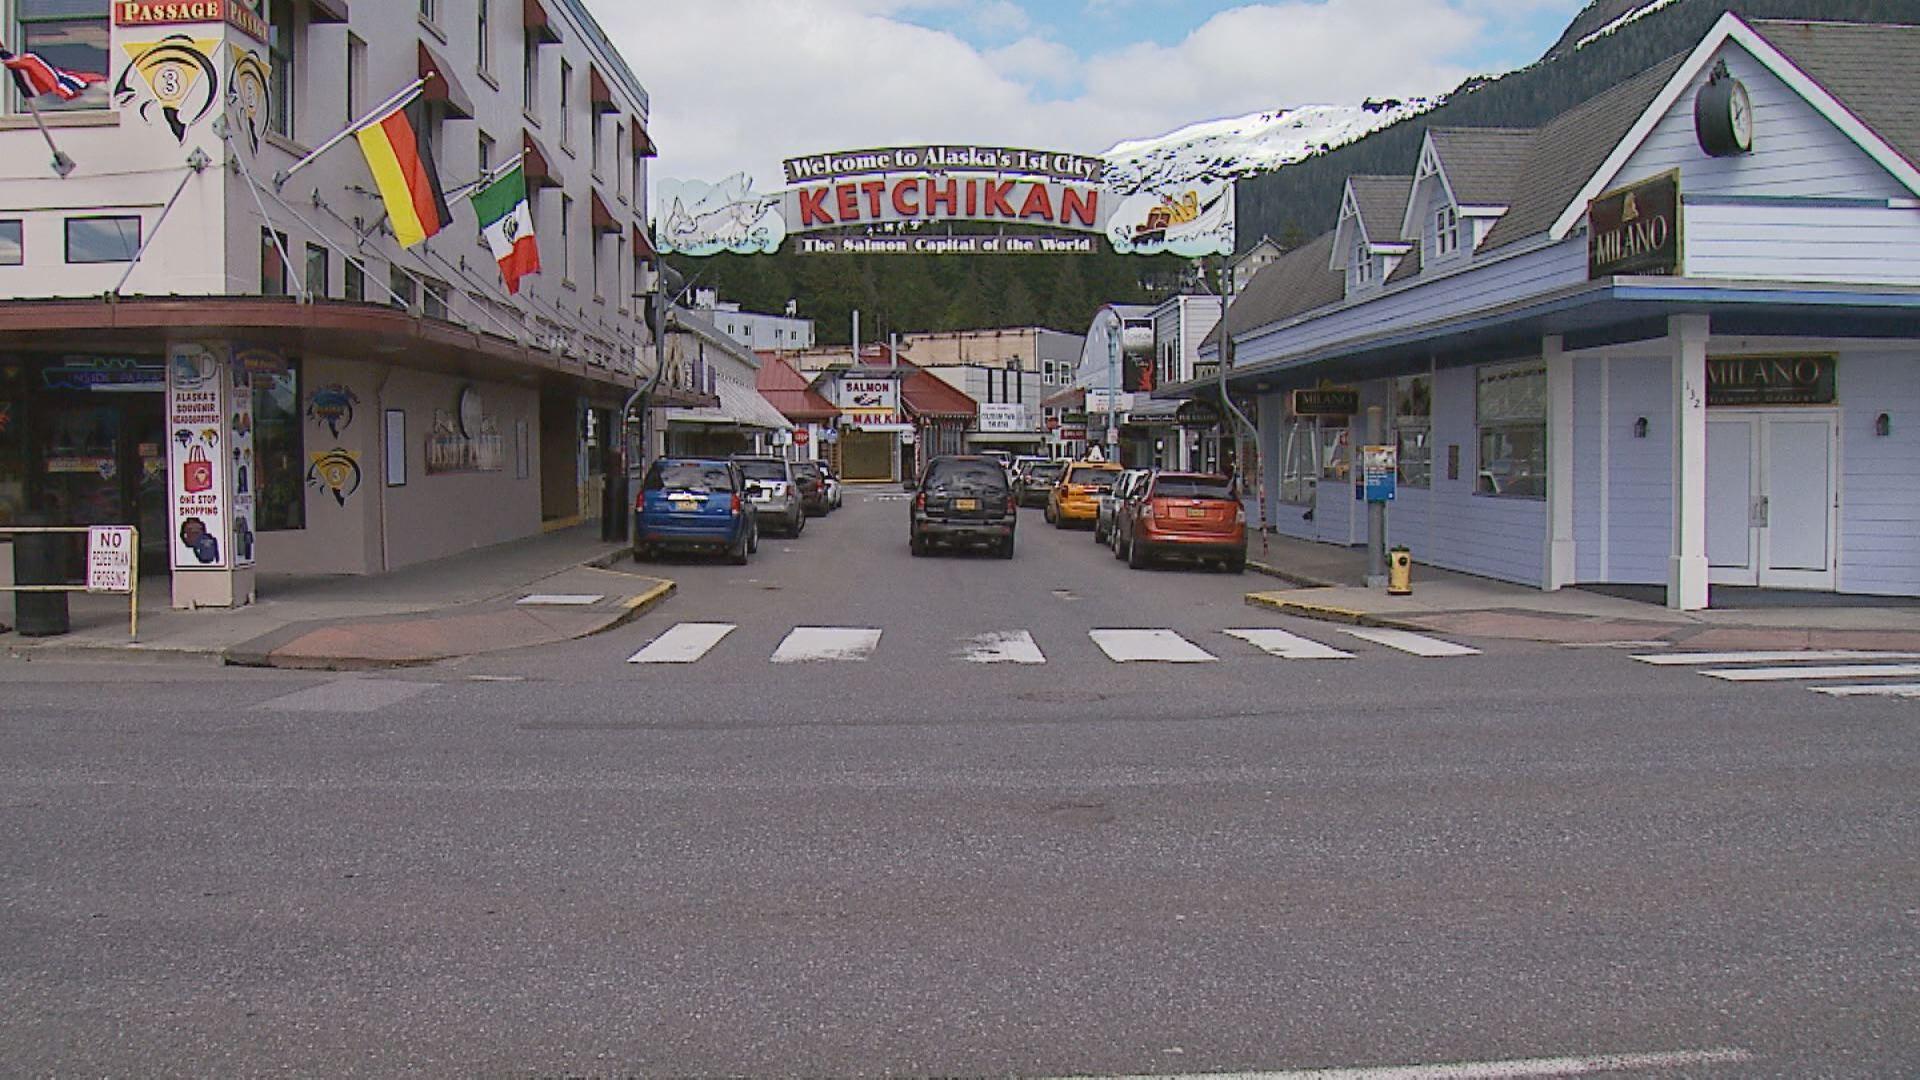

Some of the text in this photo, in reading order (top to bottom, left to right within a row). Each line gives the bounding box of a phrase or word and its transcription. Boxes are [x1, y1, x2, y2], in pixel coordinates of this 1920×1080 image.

[125, 2, 218, 21] PASSAGE
[162, 69, 180, 96] 3
[792, 147, 1096, 181] Welcome to Alaska's 1st City
[799, 178, 1098, 226] KETCHIKAN
[802, 238, 1090, 253] The Salmon Capital of the World
[1596, 215, 1667, 265] MILANO
[1708, 357, 1819, 385] MILANO
[846, 382, 889, 392] SALMON
[176, 392, 216, 402] ALASKA'S
[177, 403, 216, 413] SOUVENIR
[173, 415, 220, 424] HEADQUARTERS
[180, 495, 216, 504] ONE STOP
[180, 507, 218, 515] SHOPPING
[101, 533, 122, 548] NO
